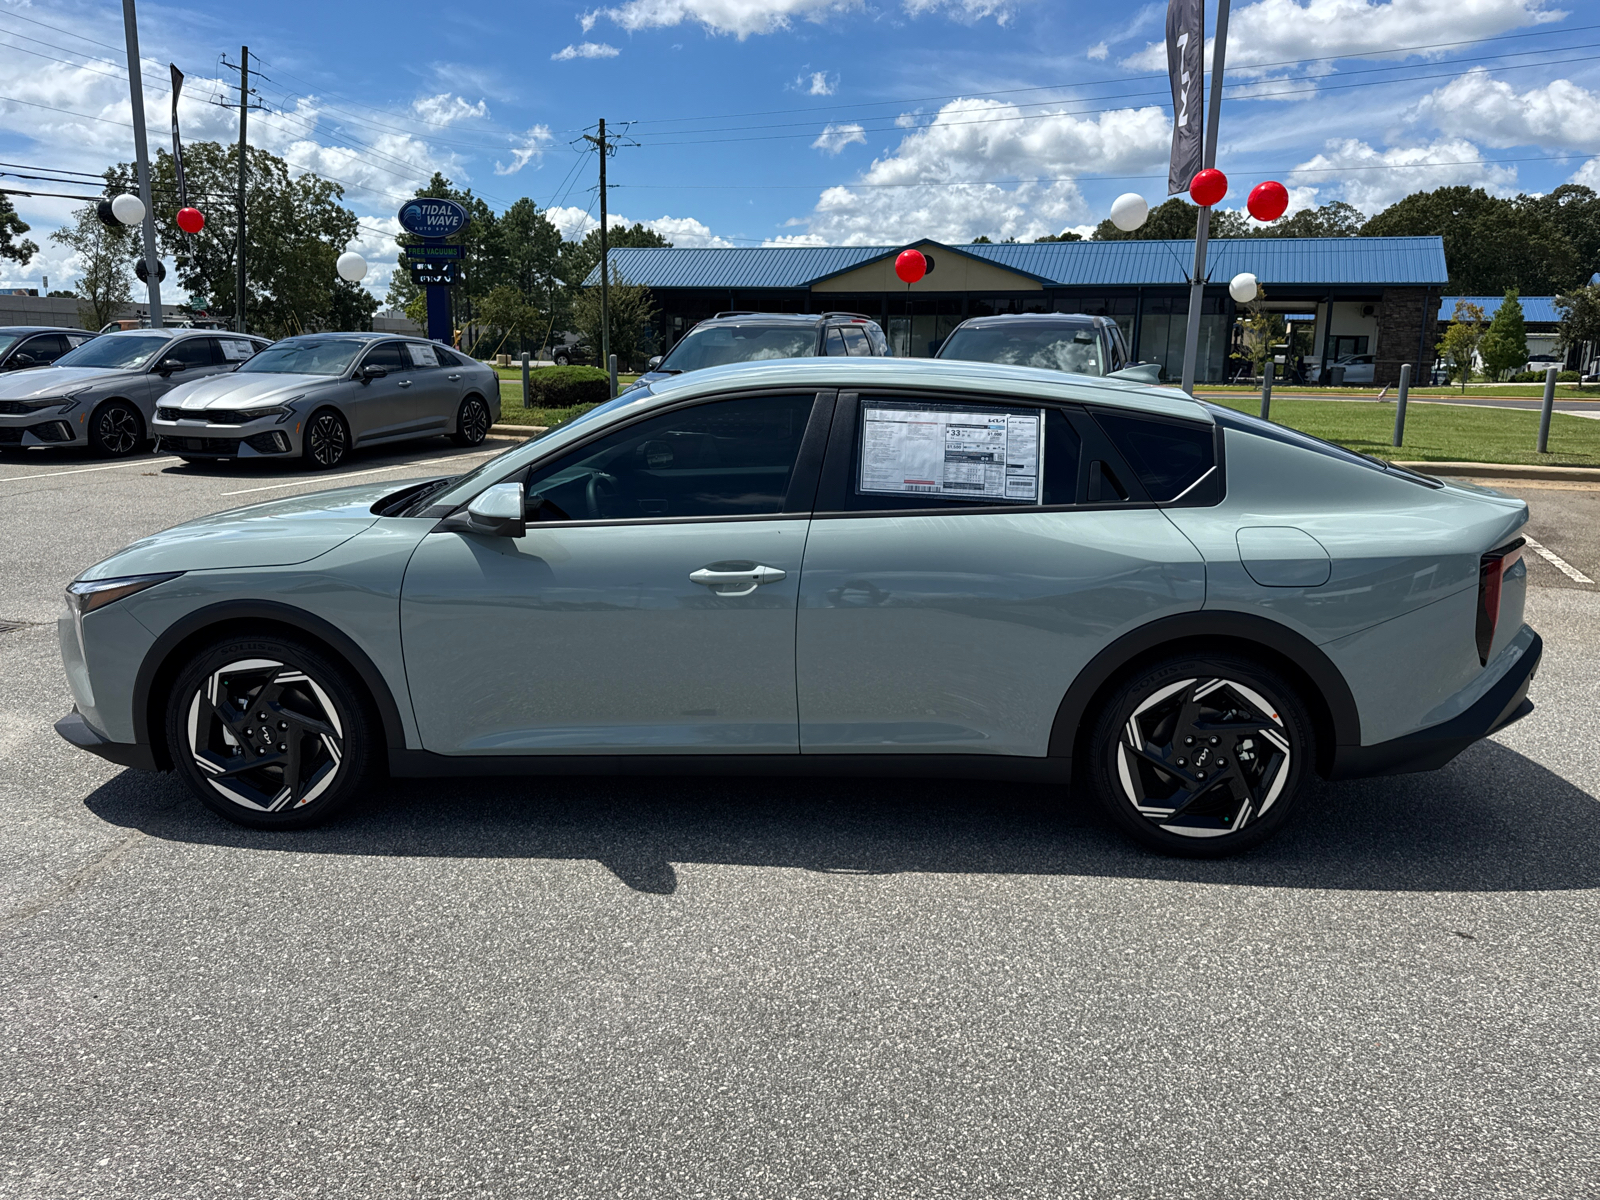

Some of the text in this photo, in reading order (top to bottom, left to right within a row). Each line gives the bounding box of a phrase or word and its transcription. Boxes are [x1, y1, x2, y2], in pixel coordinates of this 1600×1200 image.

[422, 205, 452, 215] TIDAL
[427, 216, 459, 226] WAVE
[221, 643, 267, 655] SOLUS
